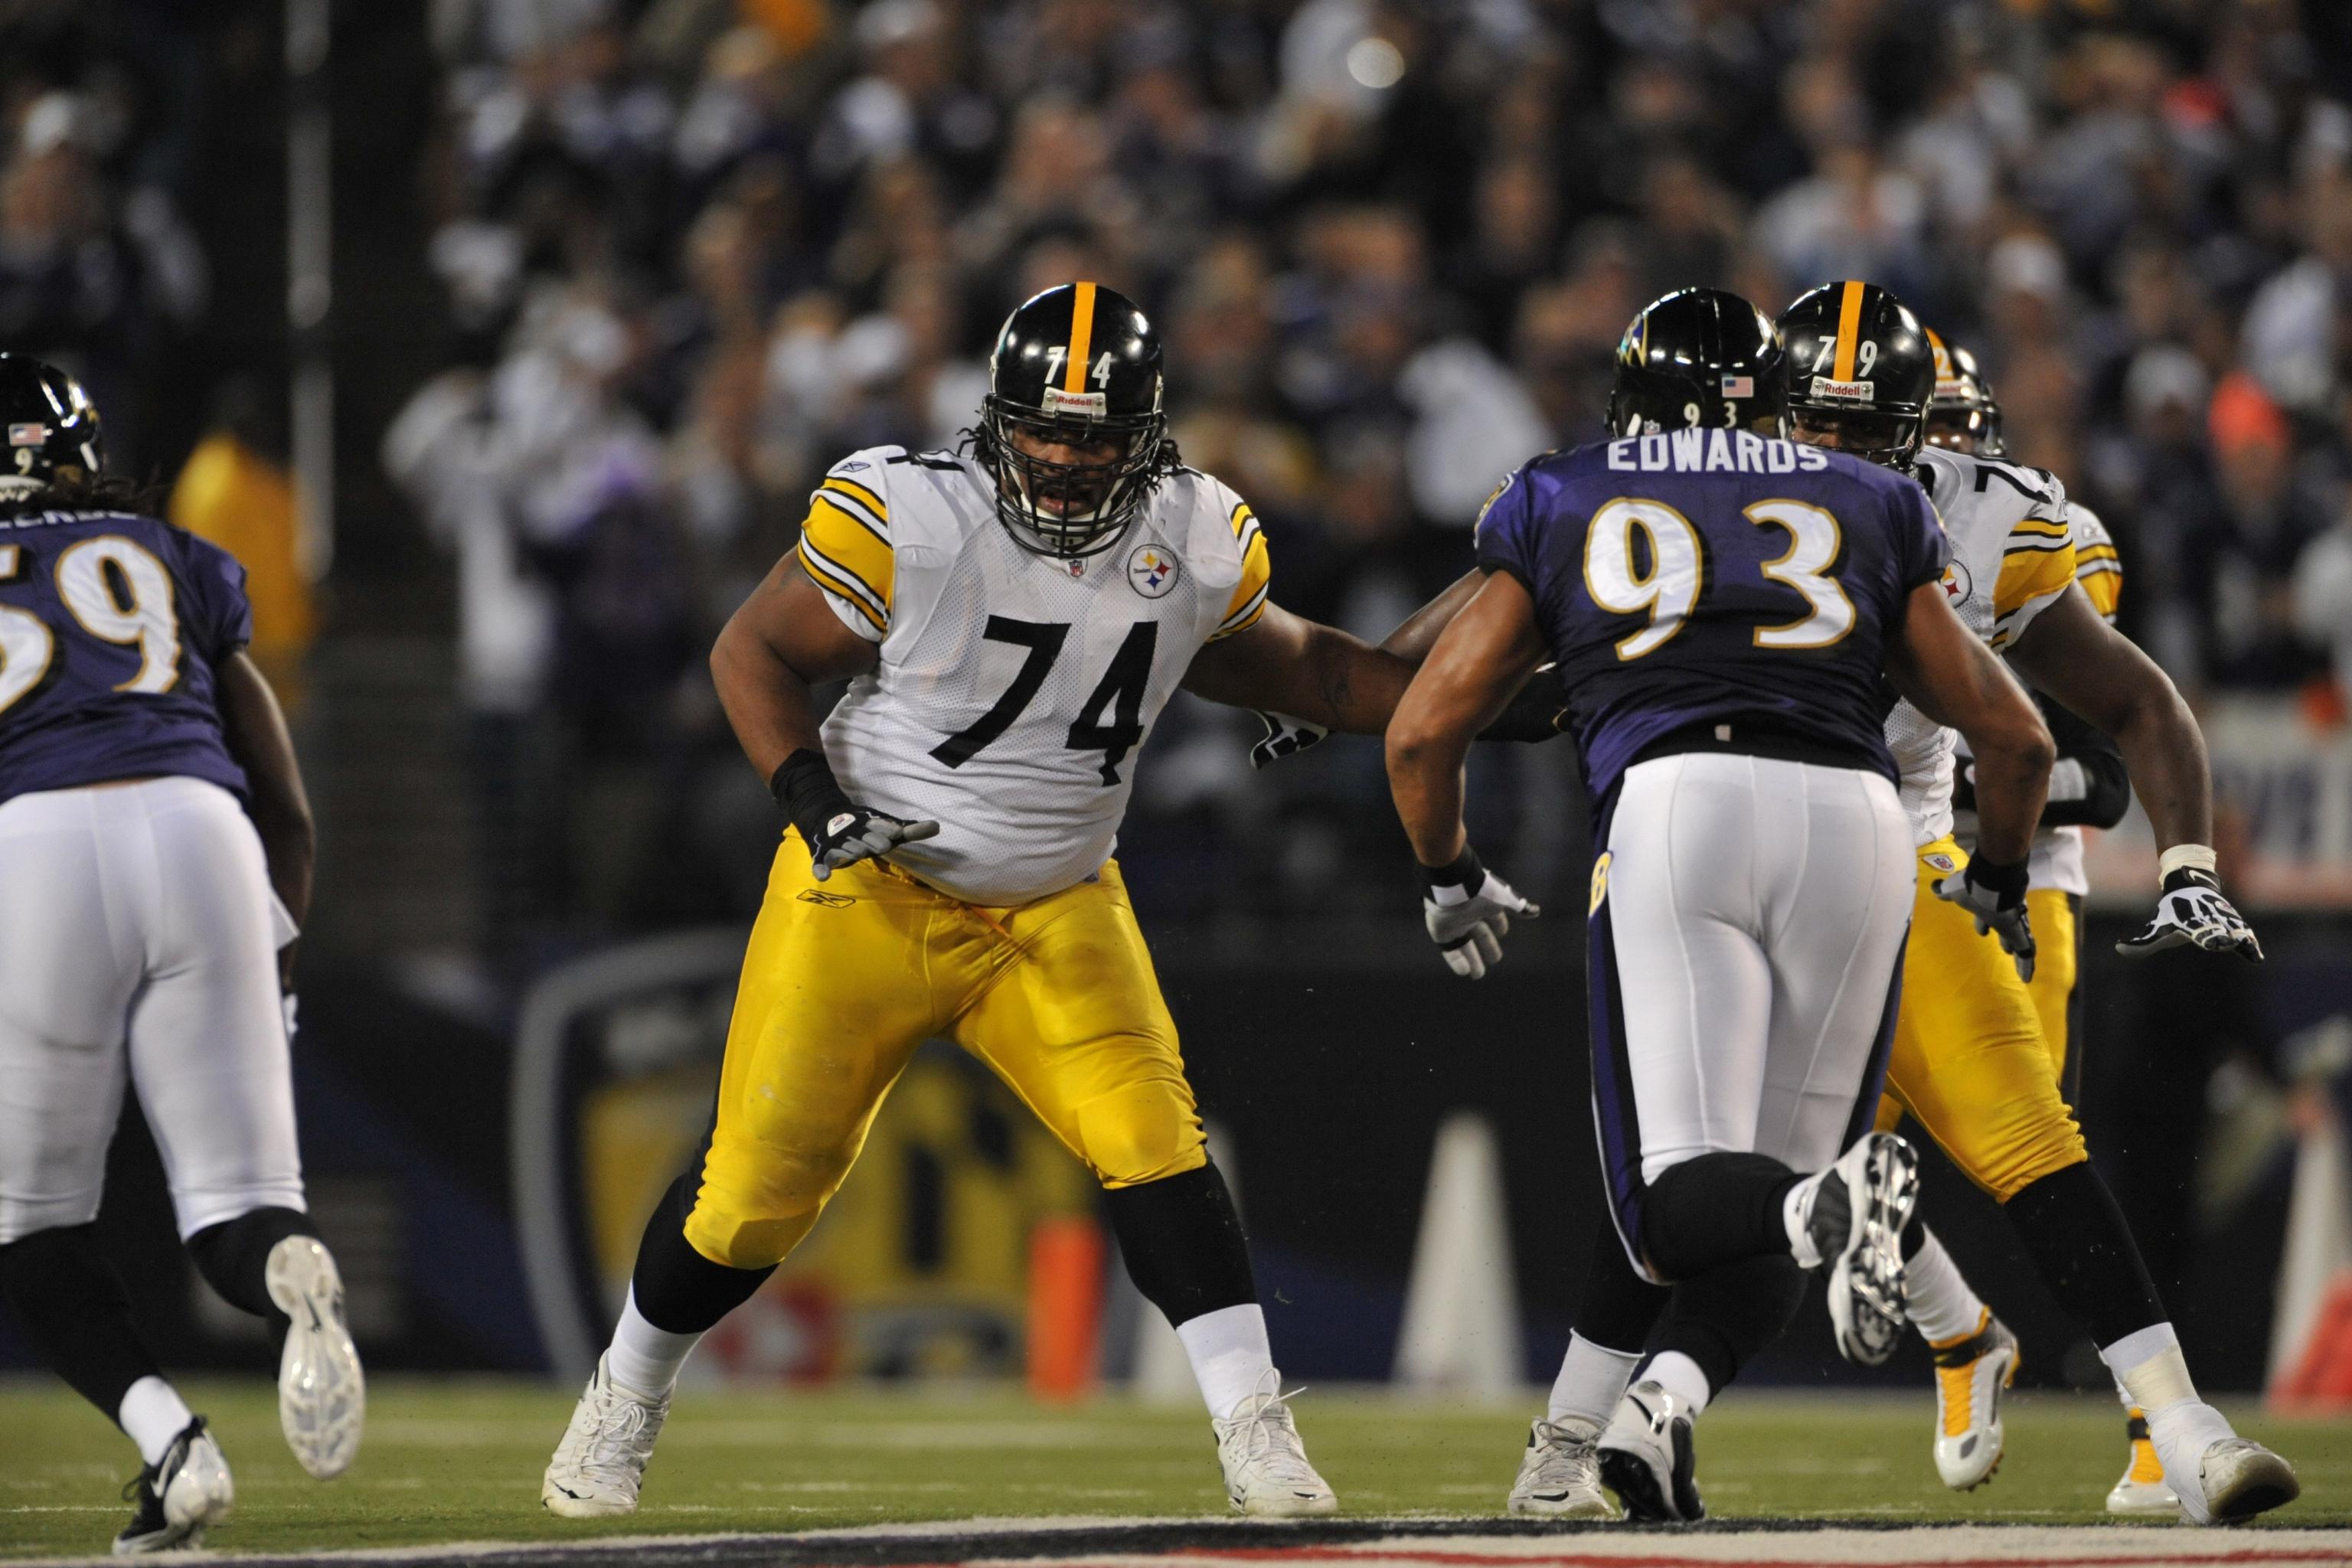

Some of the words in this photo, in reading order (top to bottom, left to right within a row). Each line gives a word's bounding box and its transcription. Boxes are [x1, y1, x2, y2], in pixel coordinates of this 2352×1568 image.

[1057, 396, 1092, 407] Riddell
[1824, 384, 1860, 396] Riddell
[1608, 426, 1828, 474] EDWARDS
[1583, 496, 1856, 662] 93
[928, 615, 1158, 787] 74
